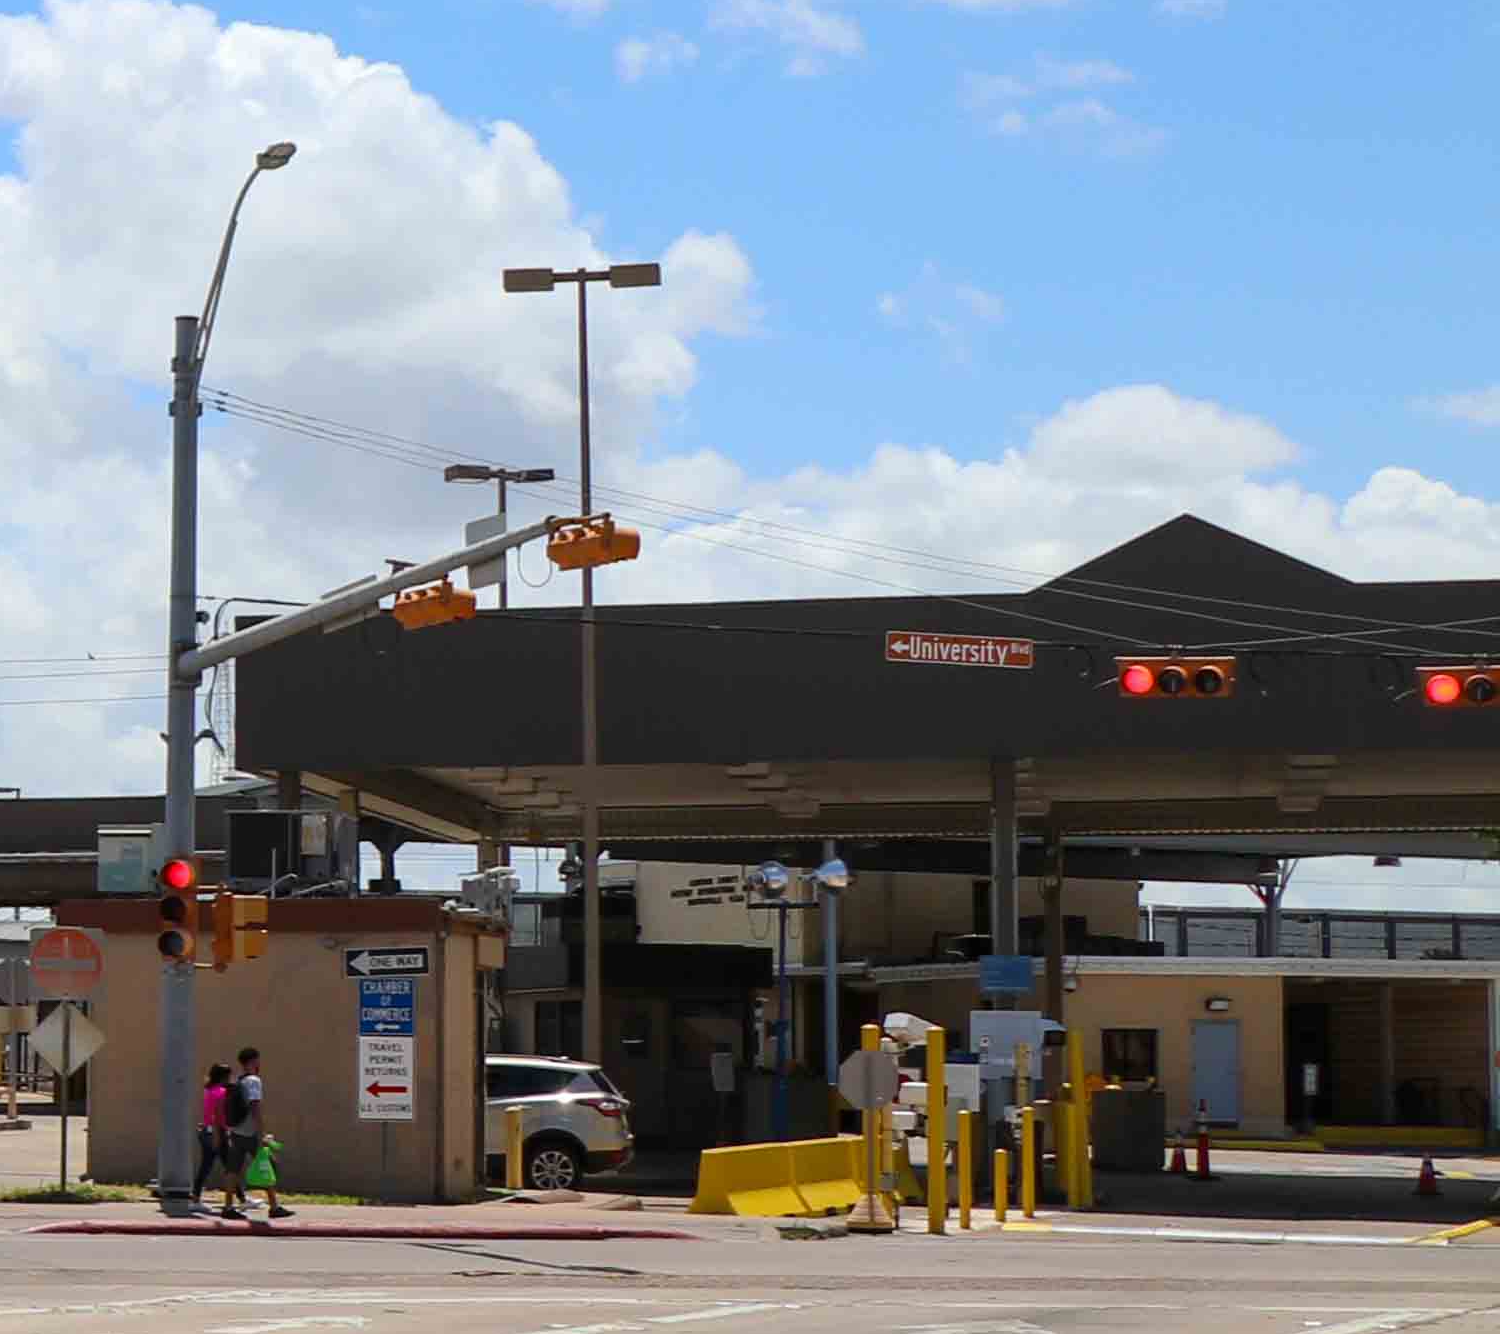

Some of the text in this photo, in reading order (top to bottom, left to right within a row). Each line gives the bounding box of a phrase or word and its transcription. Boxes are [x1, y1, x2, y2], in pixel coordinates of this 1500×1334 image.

[909, 635, 1008, 666] University
[370, 954, 422, 968] ONE WAY
[363, 981, 411, 995] CHAMBER
[362, 1008, 412, 1021] COMMERCE
[368, 1043, 404, 1052] TRAVEL
[368, 1055, 403, 1064] PERMIT
[364, 1067, 408, 1076] RETURNS
